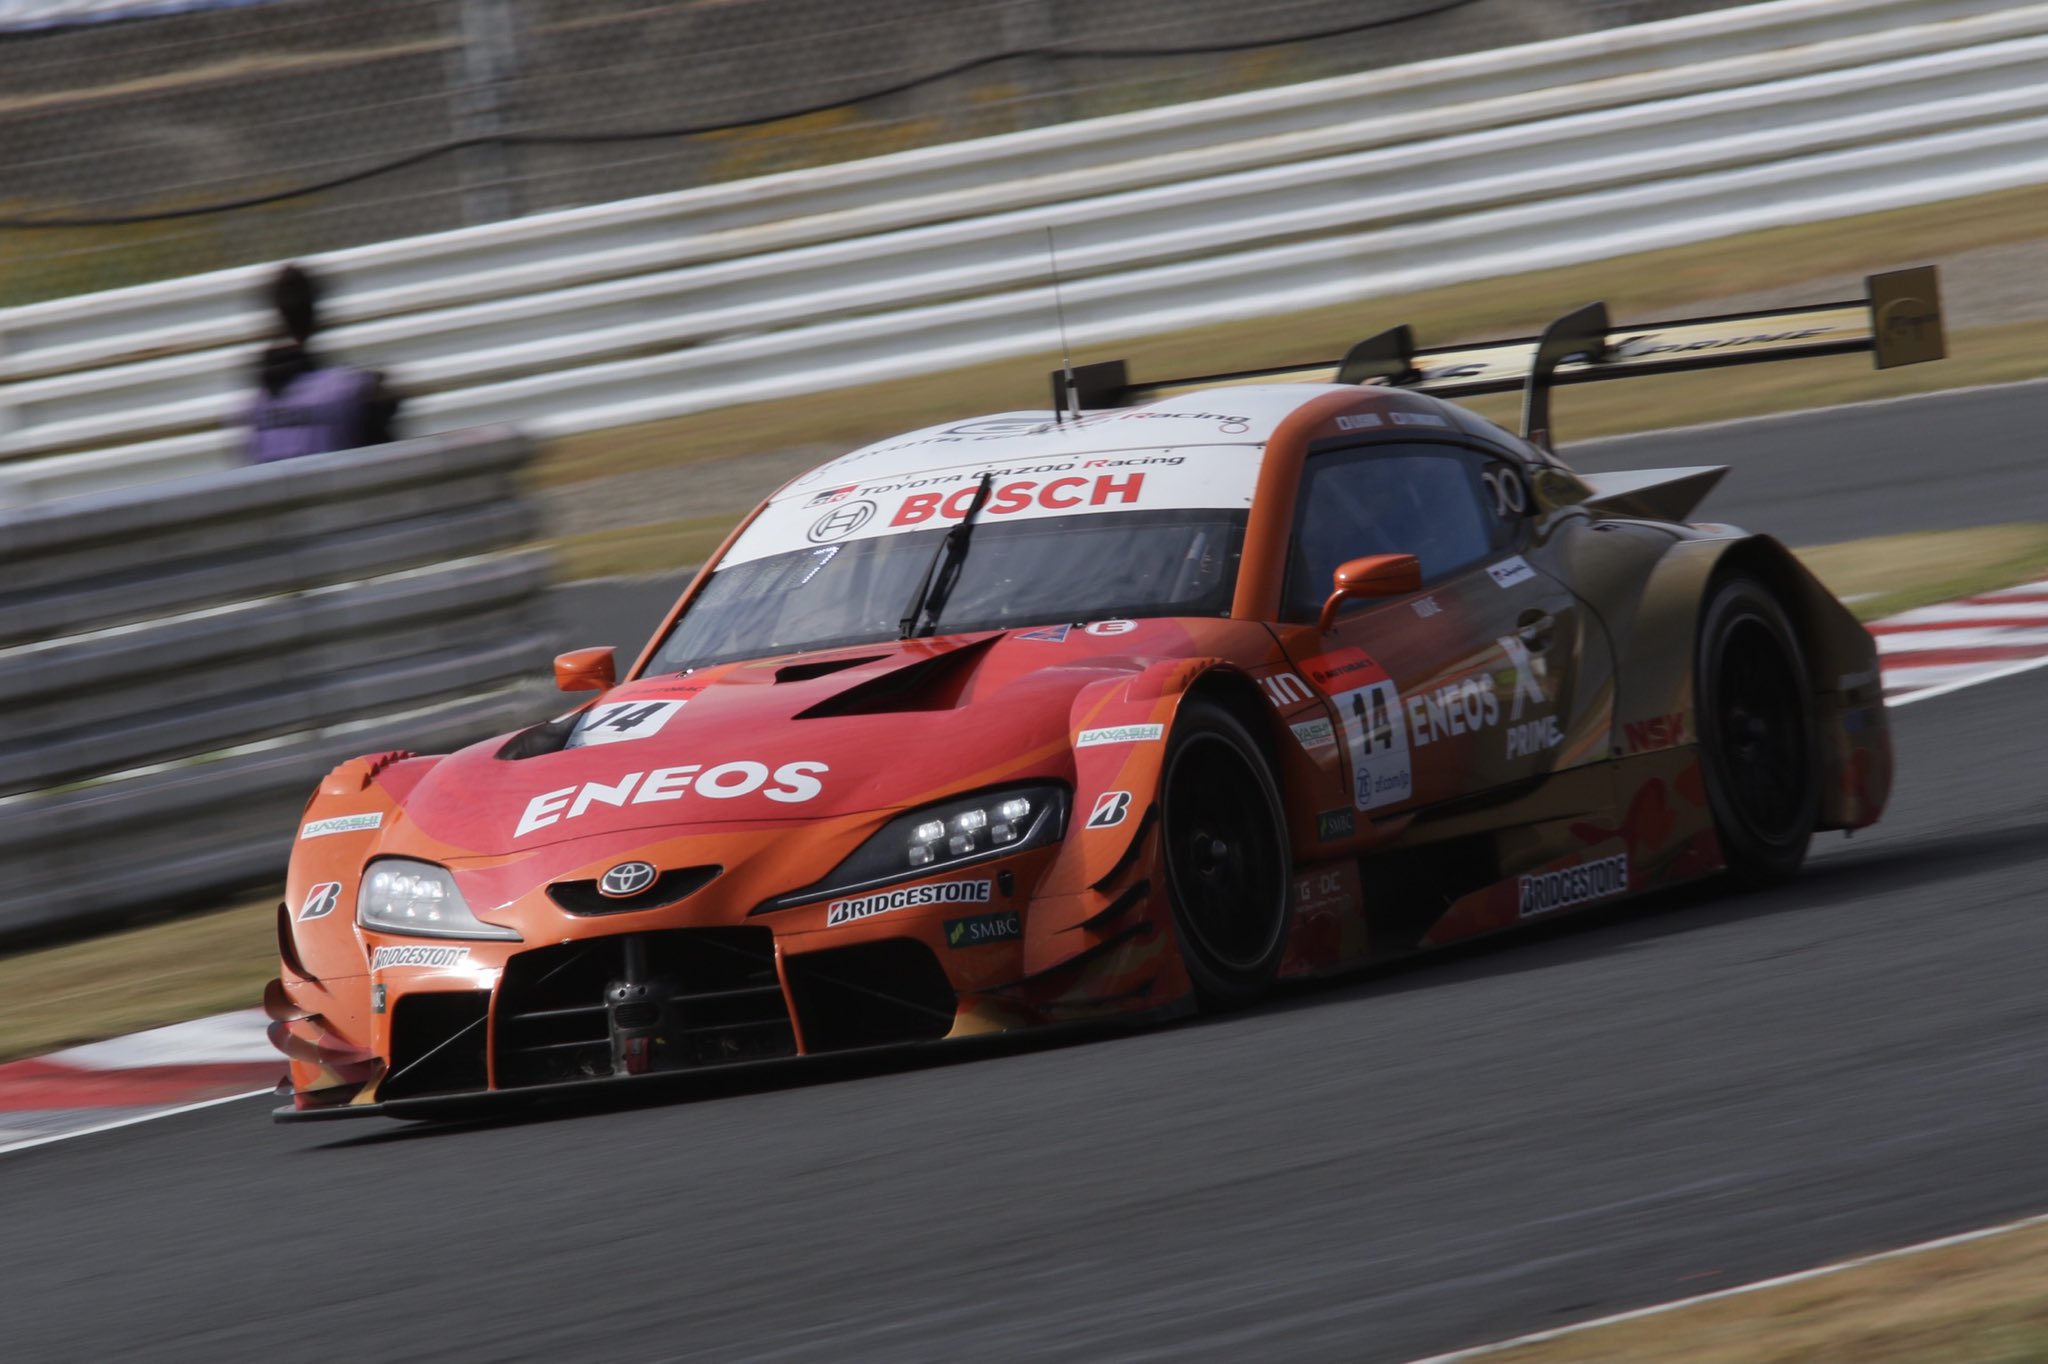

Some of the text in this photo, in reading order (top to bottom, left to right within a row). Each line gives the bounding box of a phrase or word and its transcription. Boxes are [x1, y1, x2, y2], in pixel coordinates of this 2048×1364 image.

[1120, 411, 1251, 424] Racing
[859, 456, 1187, 497] TOYOTA GAZOO Racing
[888, 472, 1146, 528] BOSCH
[581, 702, 671, 732] 14
[1353, 687, 1393, 755] 14
[1406, 672, 1500, 747] ENEOS
[1081, 727, 1160, 742] HAYASHI
[1506, 714, 1565, 760] PRIME
[1624, 712, 1686, 752] NSK
[513, 760, 830, 838] ENEOS
[304, 814, 381, 834] HAYASHI
[830, 881, 991, 925] BRIDGESTONE
[1521, 856, 1628, 914] BRIDGESTONE
[969, 917, 1019, 940] SMBC
[374, 947, 467, 970] BRIDGESTONE
